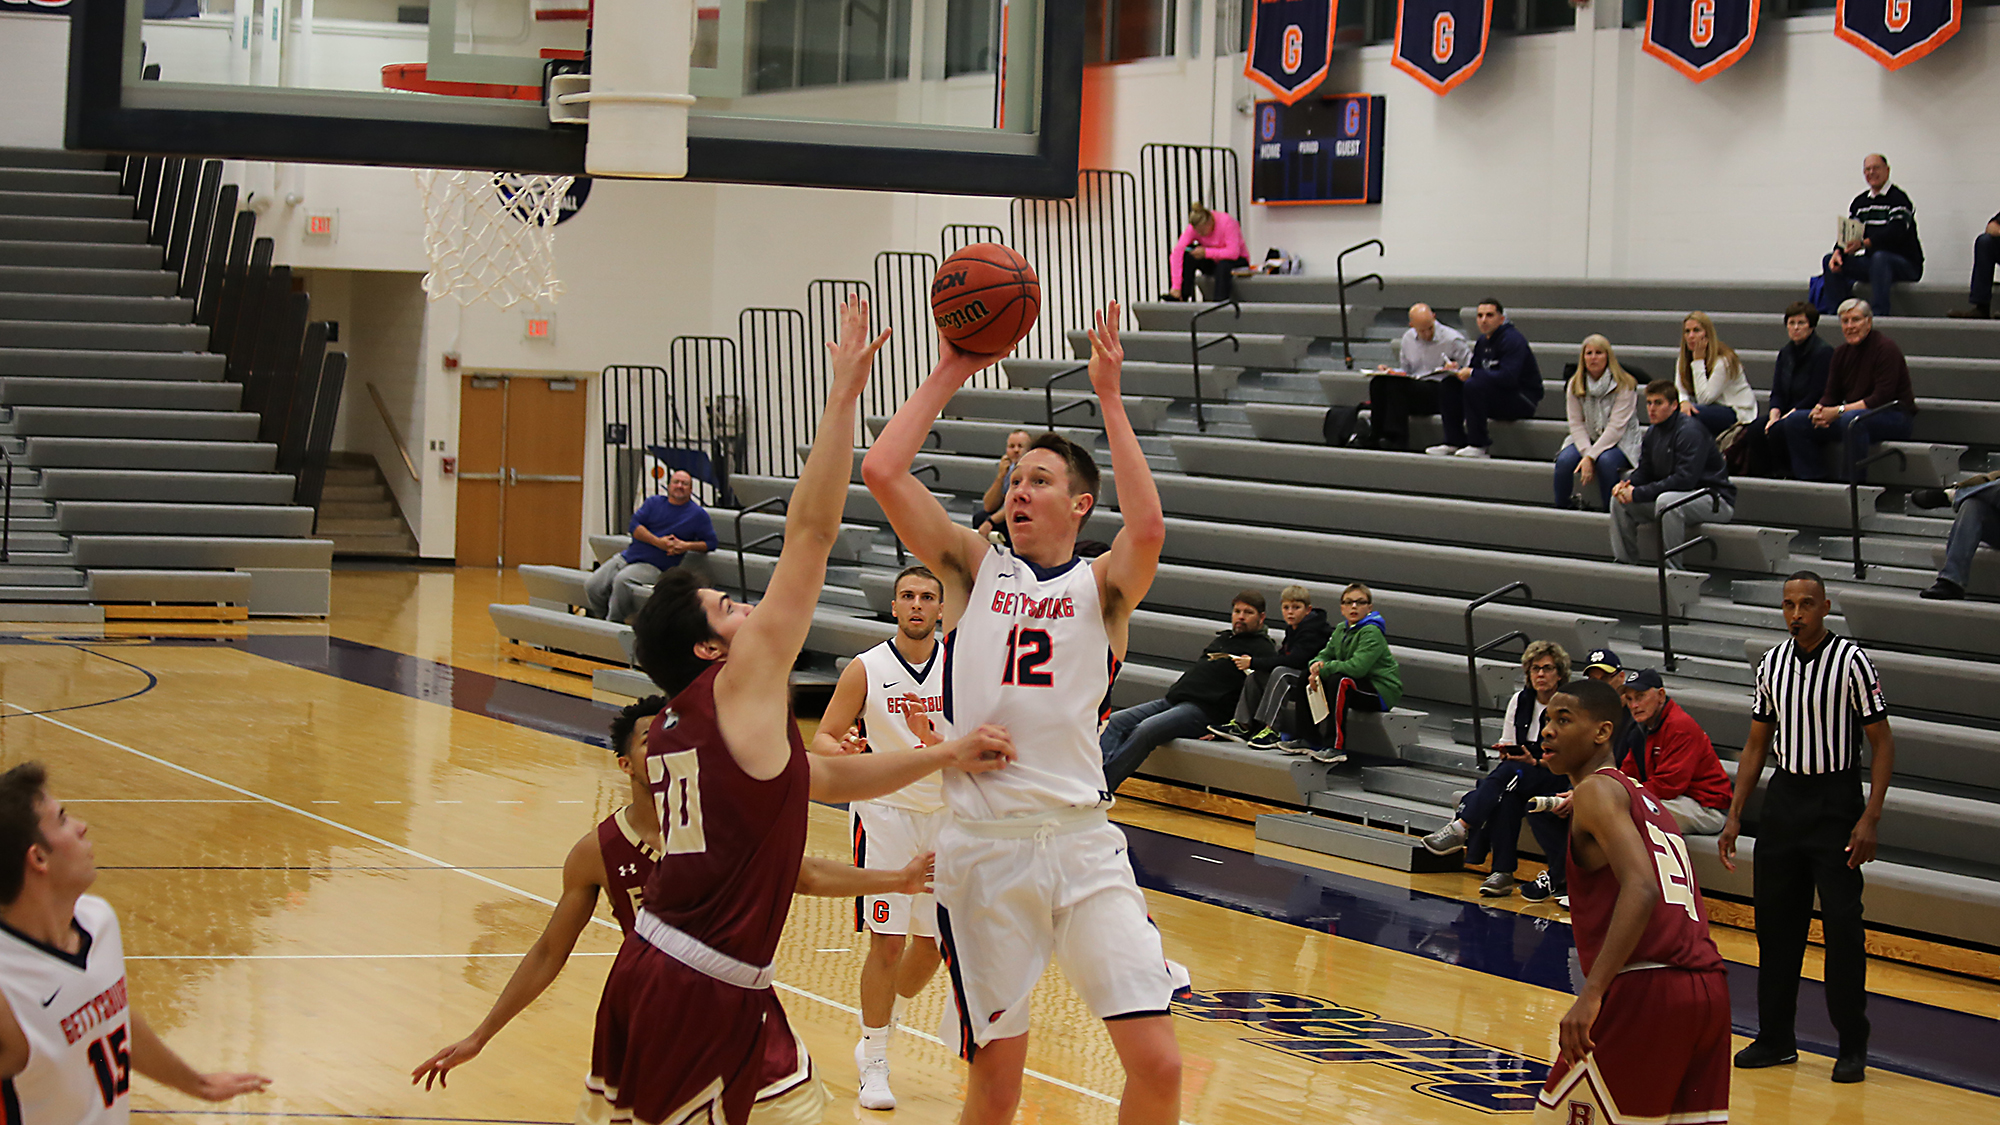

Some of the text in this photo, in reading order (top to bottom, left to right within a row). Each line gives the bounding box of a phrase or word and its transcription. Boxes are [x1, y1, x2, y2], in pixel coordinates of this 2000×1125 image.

[1432, 11, 1455, 64] G
[1690, 0, 1715, 48] G
[1282, 24, 1303, 74] G
[1262, 105, 1276, 141] G
[1345, 99, 1360, 137] G
[1260, 143, 1281, 159] HOME
[1335, 139, 1361, 157] GUEST
[311, 216, 331, 234] EXIT
[528, 319, 548, 337] EXIT
[937, 299, 991, 329] Wilso
[1001, 623, 1054, 688] 12
[872, 899, 890, 924] G
[87, 1022, 130, 1109] 15
